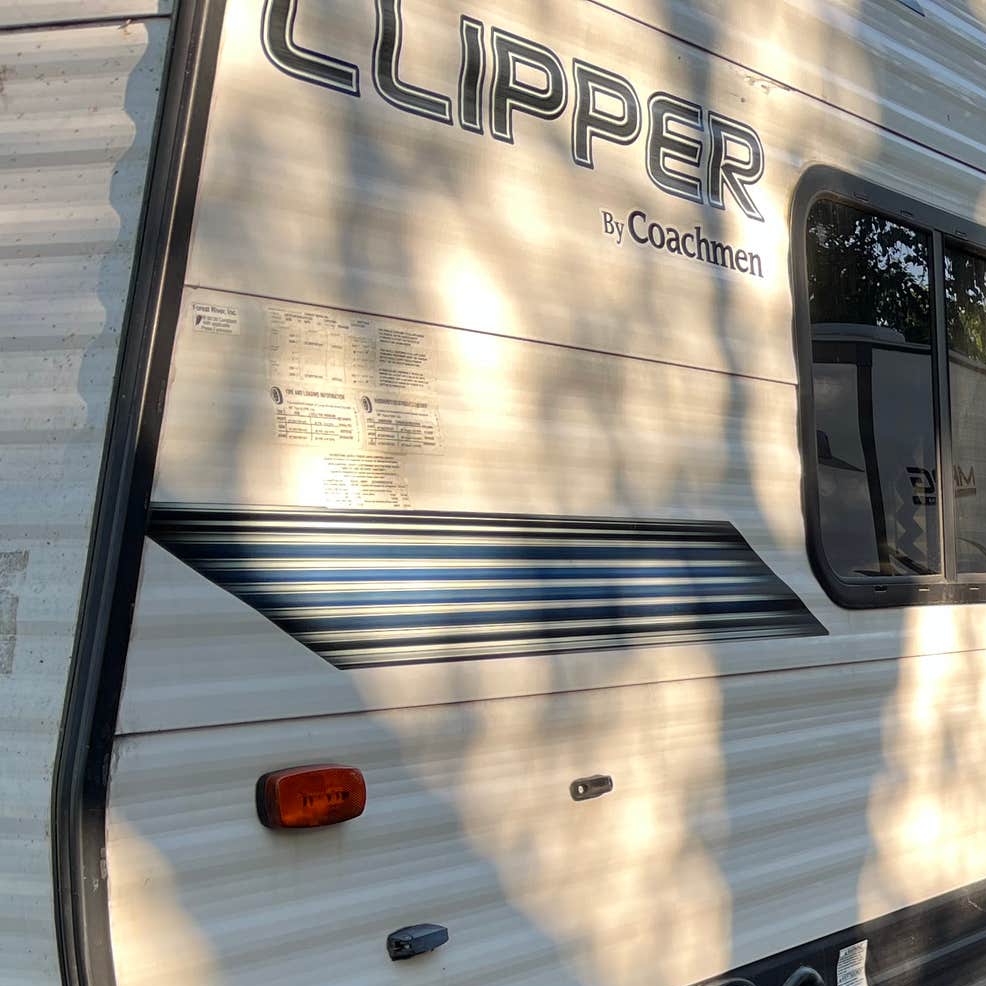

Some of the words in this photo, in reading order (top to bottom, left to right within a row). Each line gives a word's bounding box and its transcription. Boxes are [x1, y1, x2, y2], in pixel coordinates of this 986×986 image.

[260, 0, 764, 222] CLIPPER
[602, 210, 625, 244] By
[628, 210, 764, 278] Coachmen
